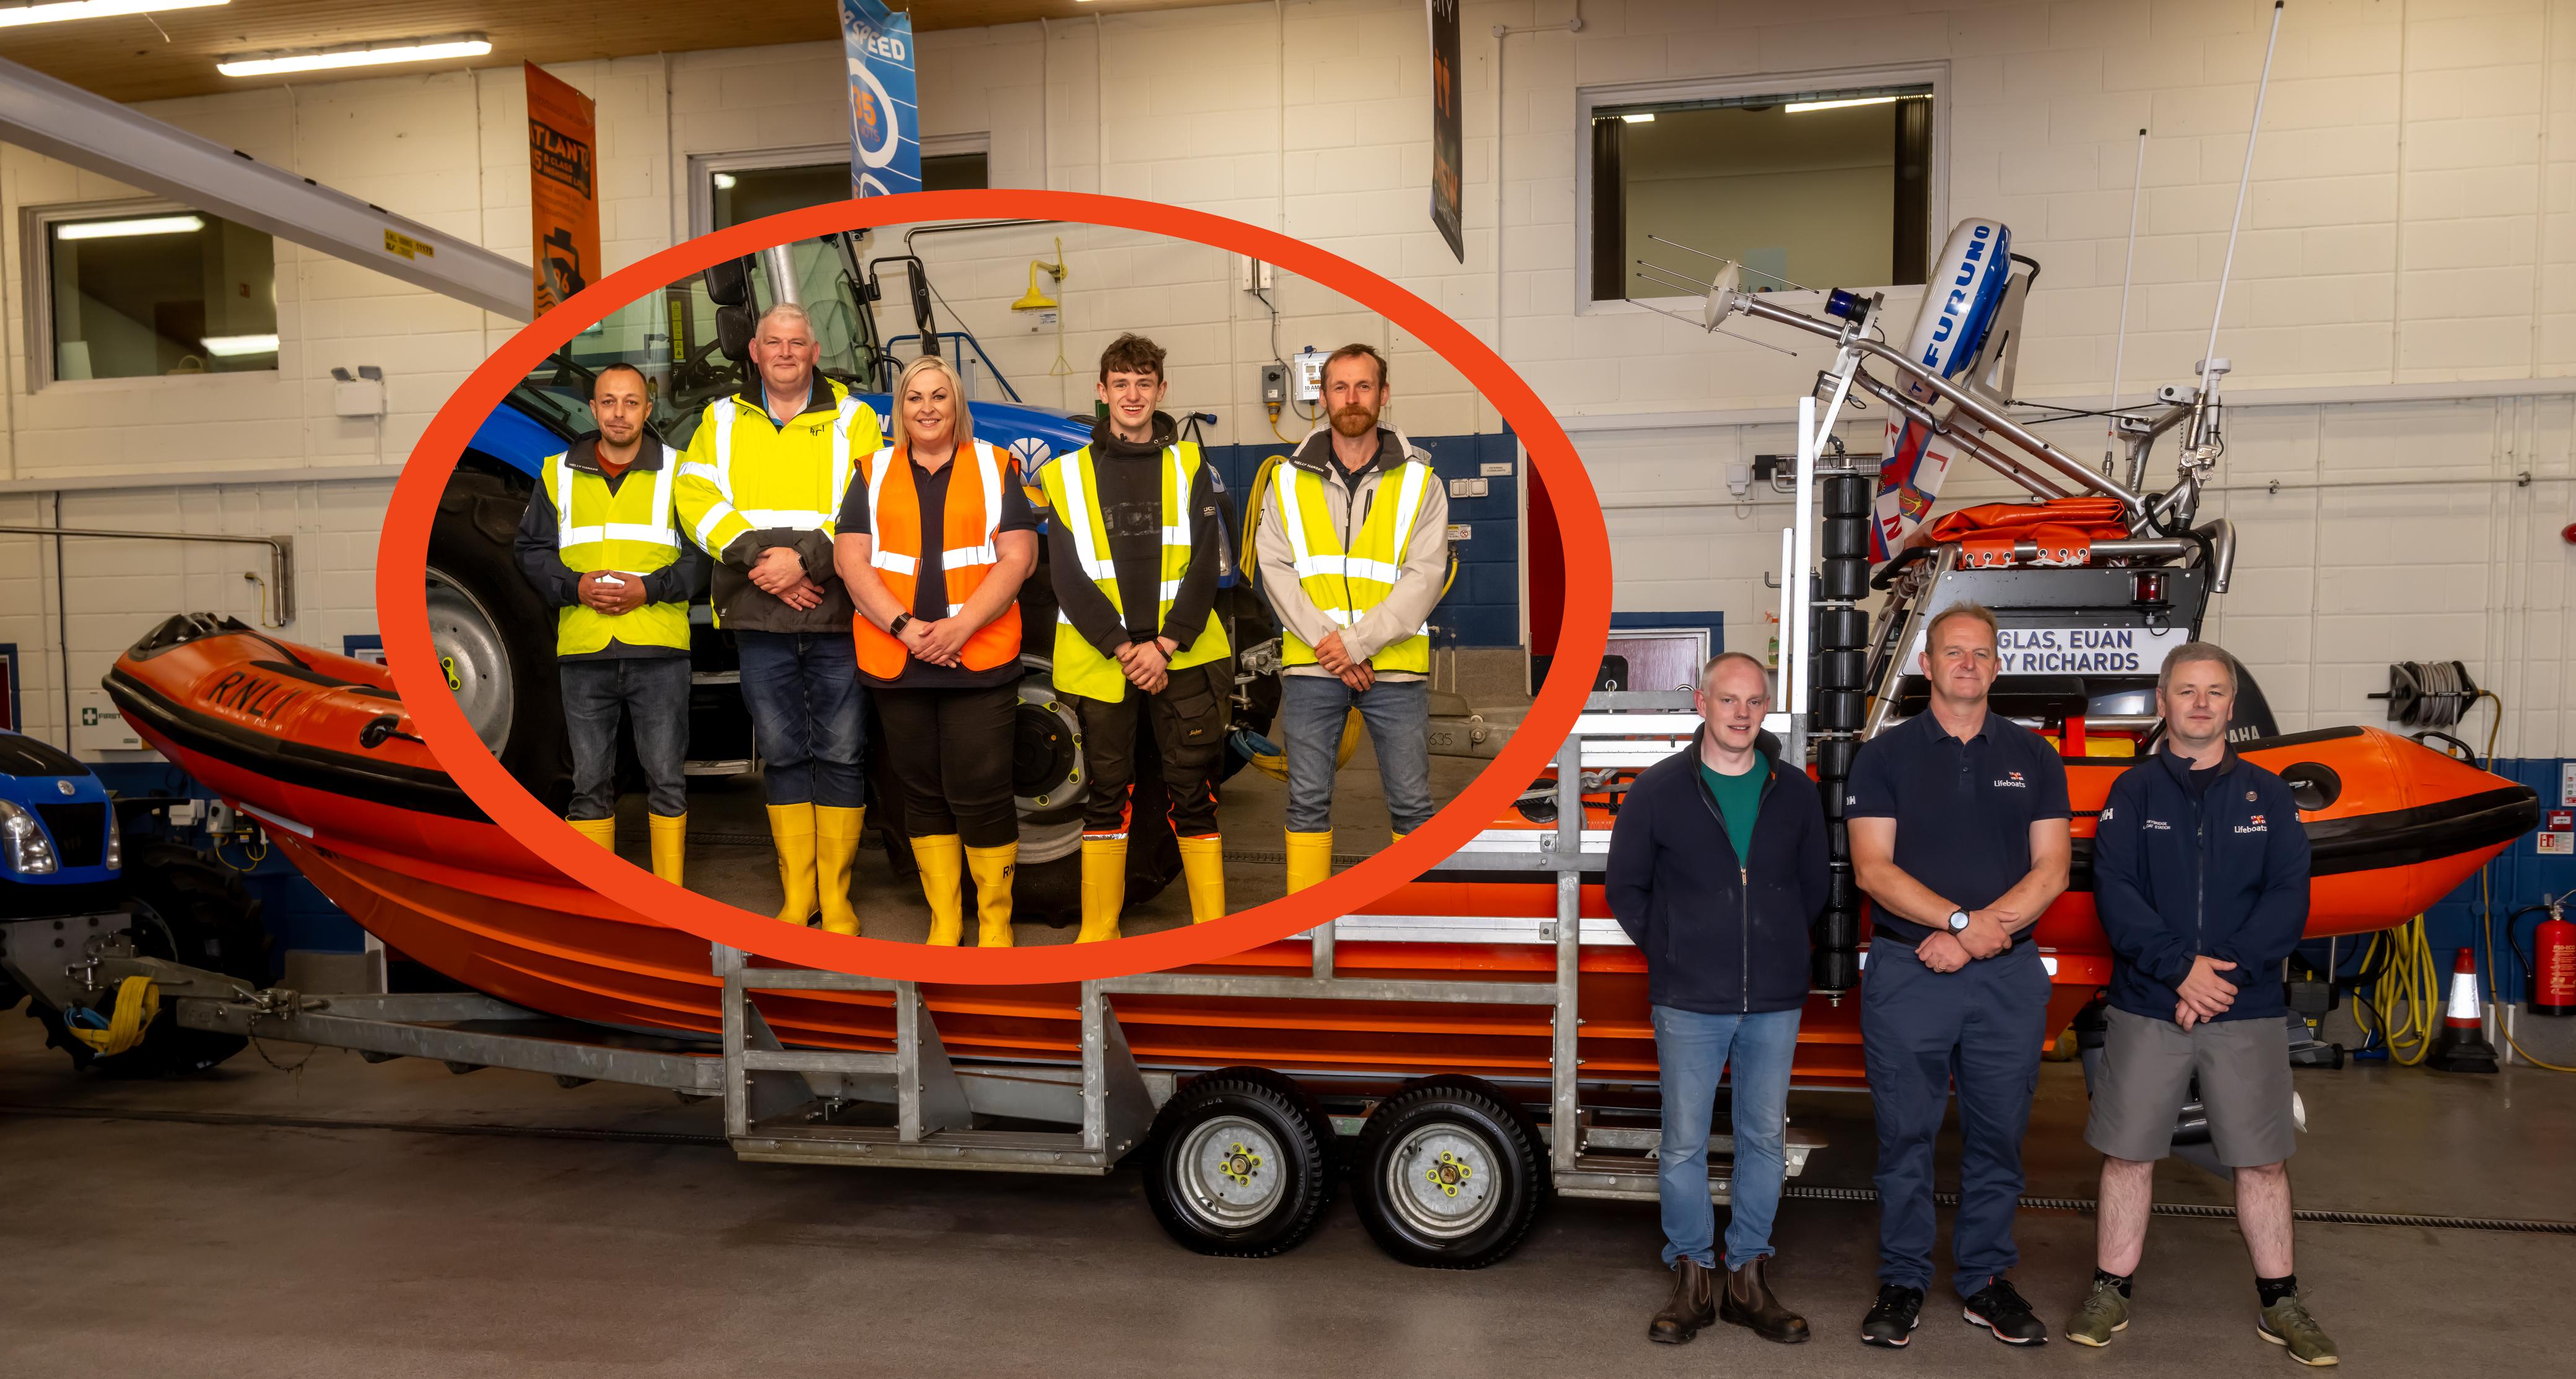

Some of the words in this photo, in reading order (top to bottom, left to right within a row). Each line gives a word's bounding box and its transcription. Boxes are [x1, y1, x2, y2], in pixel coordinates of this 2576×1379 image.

[852, 20, 905, 61] SPEED
[1922, 225, 1990, 368] FURUNO
[1307, 463, 1324, 472] HANSEN
[1998, 630, 2062, 651] GLAS,
[2069, 630, 2133, 649] EUAN
[2022, 653, 2139, 671] RICHARDS
[207, 671, 303, 720] RNLI
[1429, 733, 1453, 746] 635
[2224, 725, 2260, 743] AHA
[1994, 780, 2026, 788] Lifeboats
[2234, 825, 2268, 833] Lifeboats
